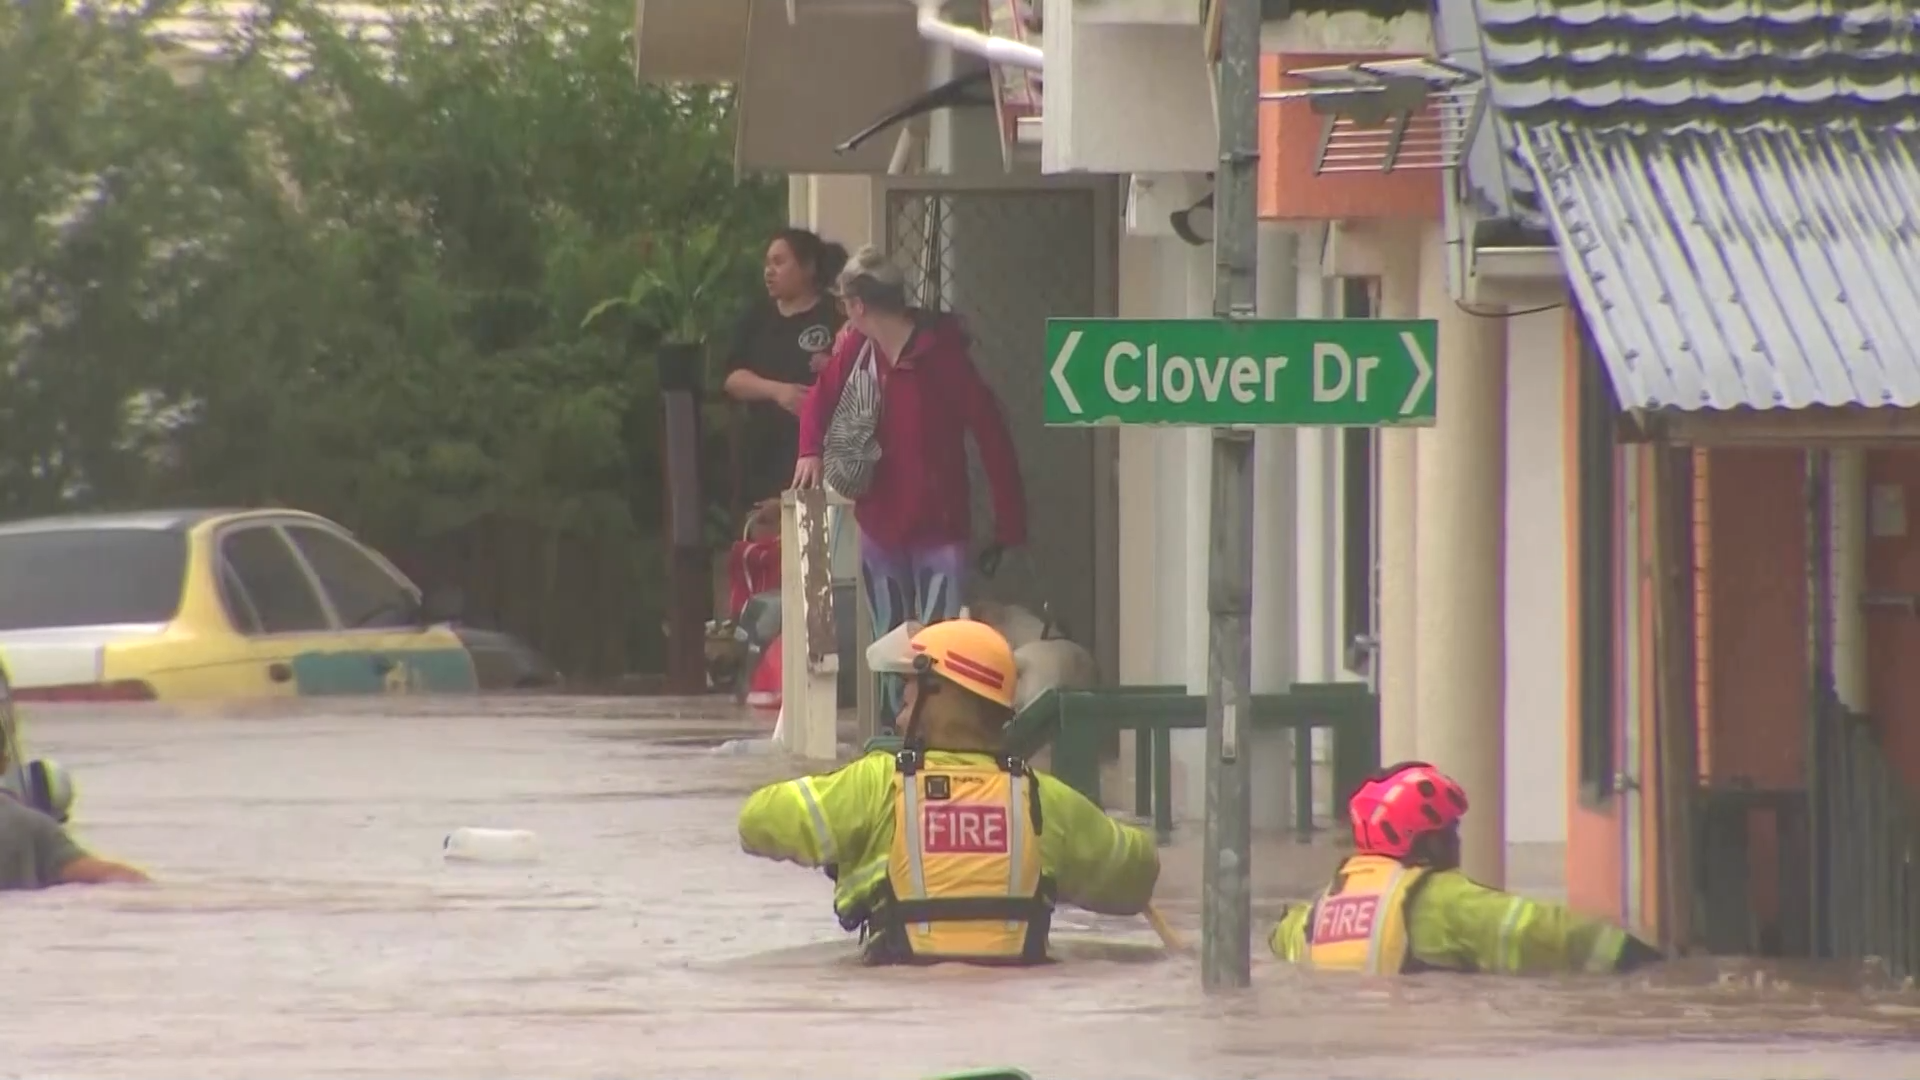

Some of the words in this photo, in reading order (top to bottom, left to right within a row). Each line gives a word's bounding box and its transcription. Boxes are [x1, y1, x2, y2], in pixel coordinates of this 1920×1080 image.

[1103, 341, 1289, 403] Clover
[1313, 342, 1380, 403] Dr
[928, 811, 1003, 847] FIRE
[1317, 901, 1375, 937] FIRE
